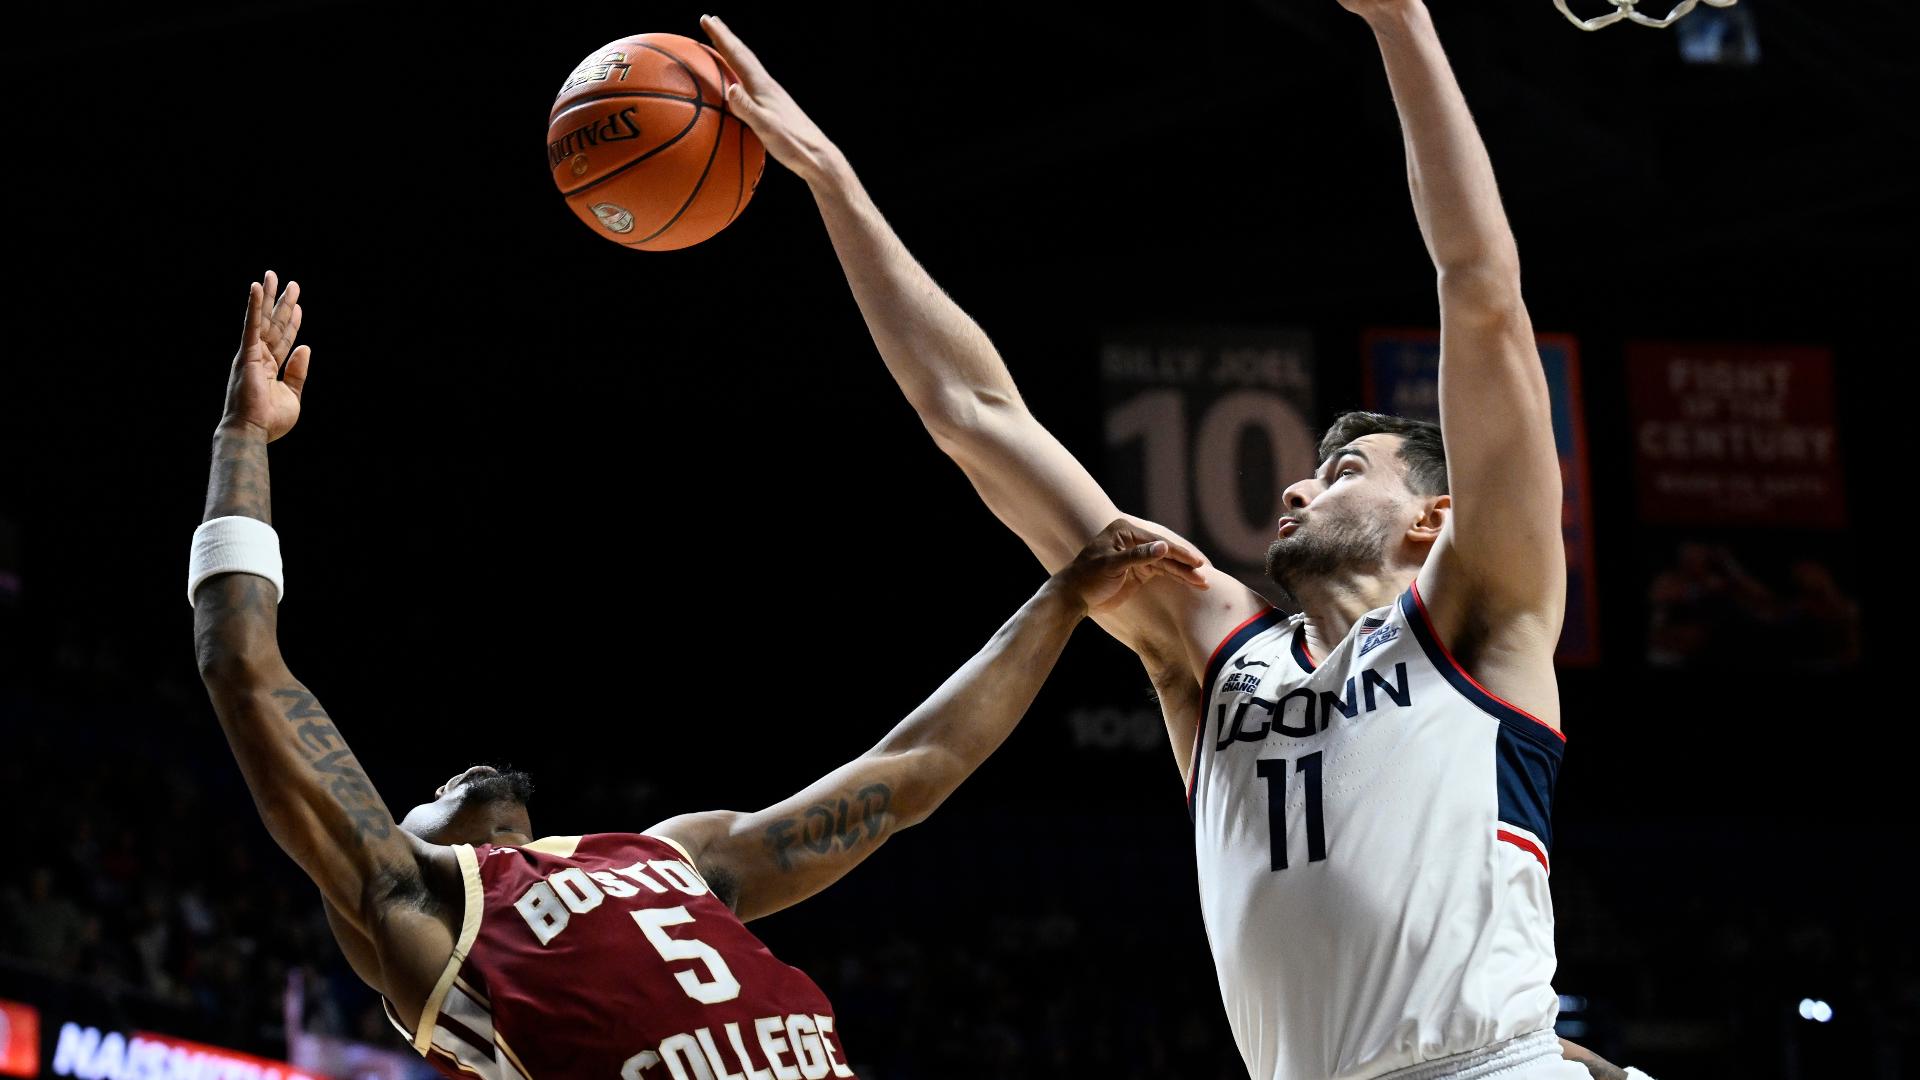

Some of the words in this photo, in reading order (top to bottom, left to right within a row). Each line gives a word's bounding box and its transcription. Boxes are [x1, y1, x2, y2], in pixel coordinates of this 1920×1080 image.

[1104, 386, 1316, 565] 10
[1639, 420, 1833, 462] CENTURY
[1216, 662, 1411, 751] UCONN
[1222, 682, 1257, 694] CHANG
[1227, 673, 1242, 683] BE
[1243, 674, 1261, 686] TH
[272, 689, 391, 847] NEVER
[1257, 751, 1326, 872] 11
[764, 783, 892, 872] FOLD
[513, 858, 717, 946] BOSTO
[629, 905, 741, 1004] 5
